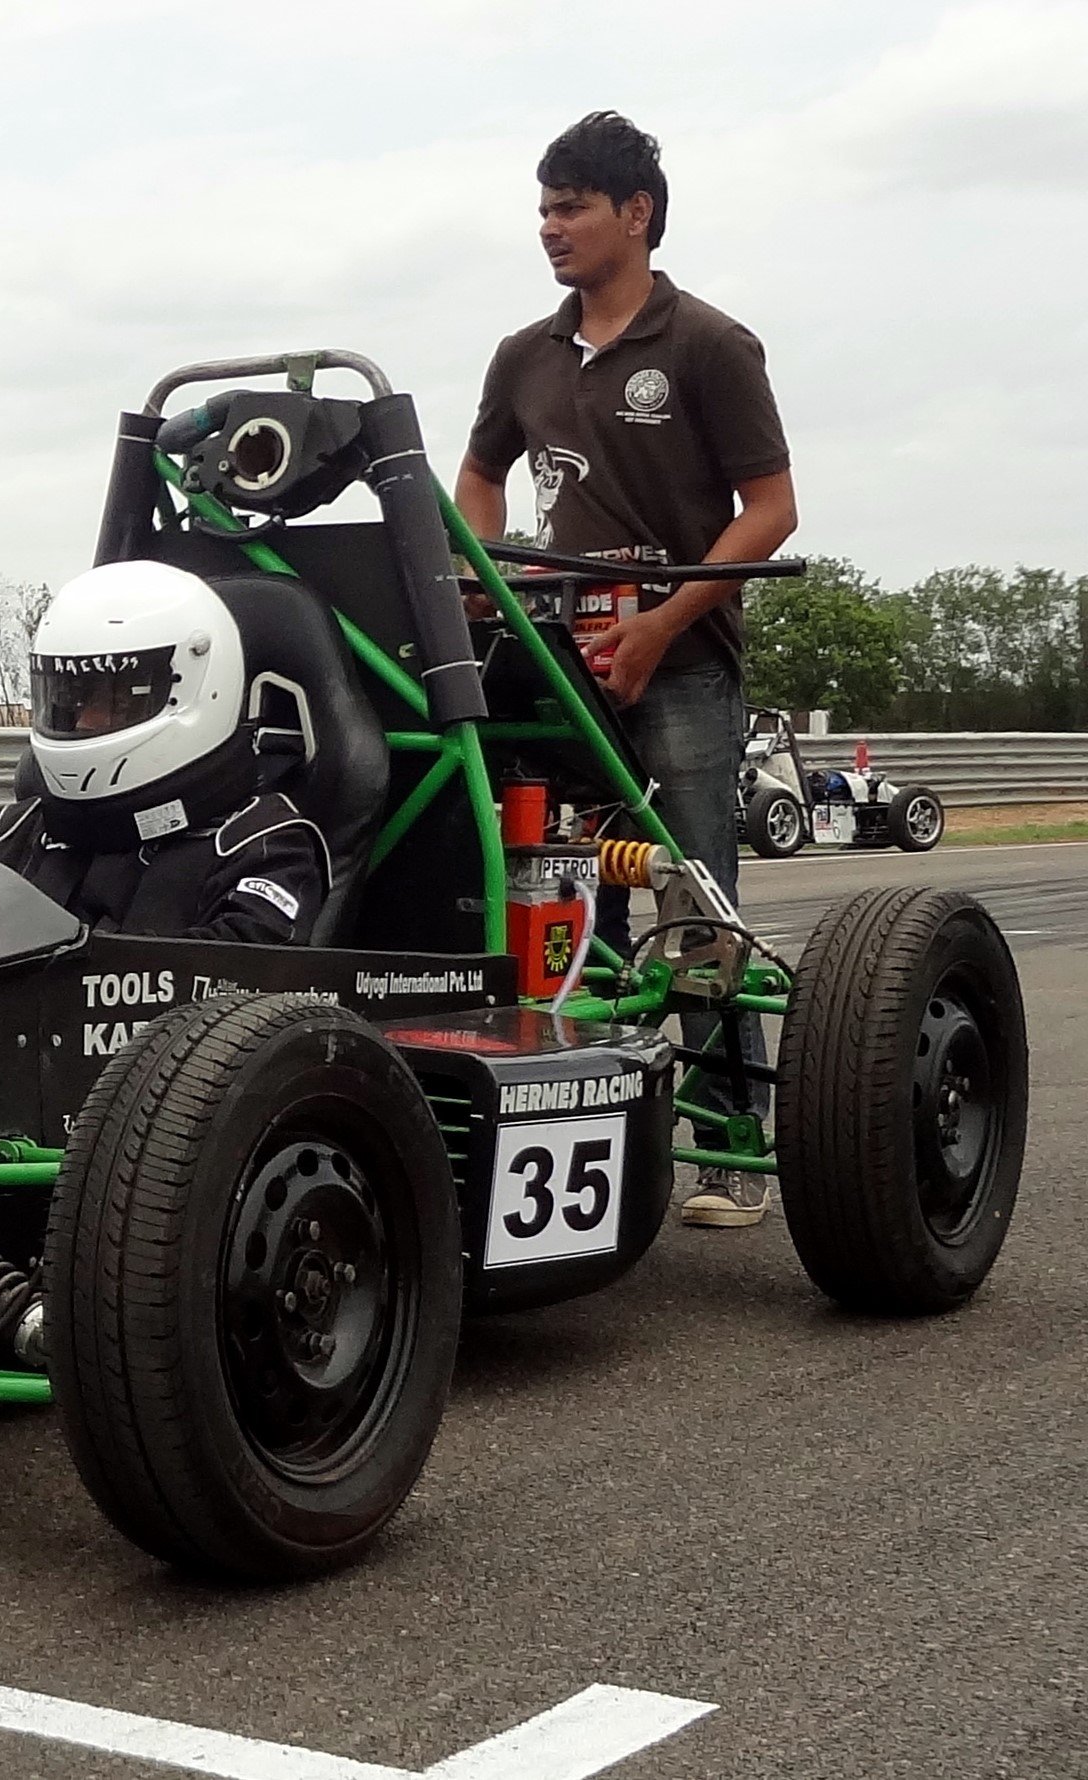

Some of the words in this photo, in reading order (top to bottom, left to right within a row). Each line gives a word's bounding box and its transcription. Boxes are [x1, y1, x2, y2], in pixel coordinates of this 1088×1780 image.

[543, 859, 596, 879] PETROL
[82, 971, 174, 1007] TOOLS
[356, 971, 388, 999] Udyogi
[390, 971, 448, 993] International
[500, 1081, 579, 1114] HERMES
[582, 1071, 643, 1107] RACING
[503, 1138, 612, 1239] 35
